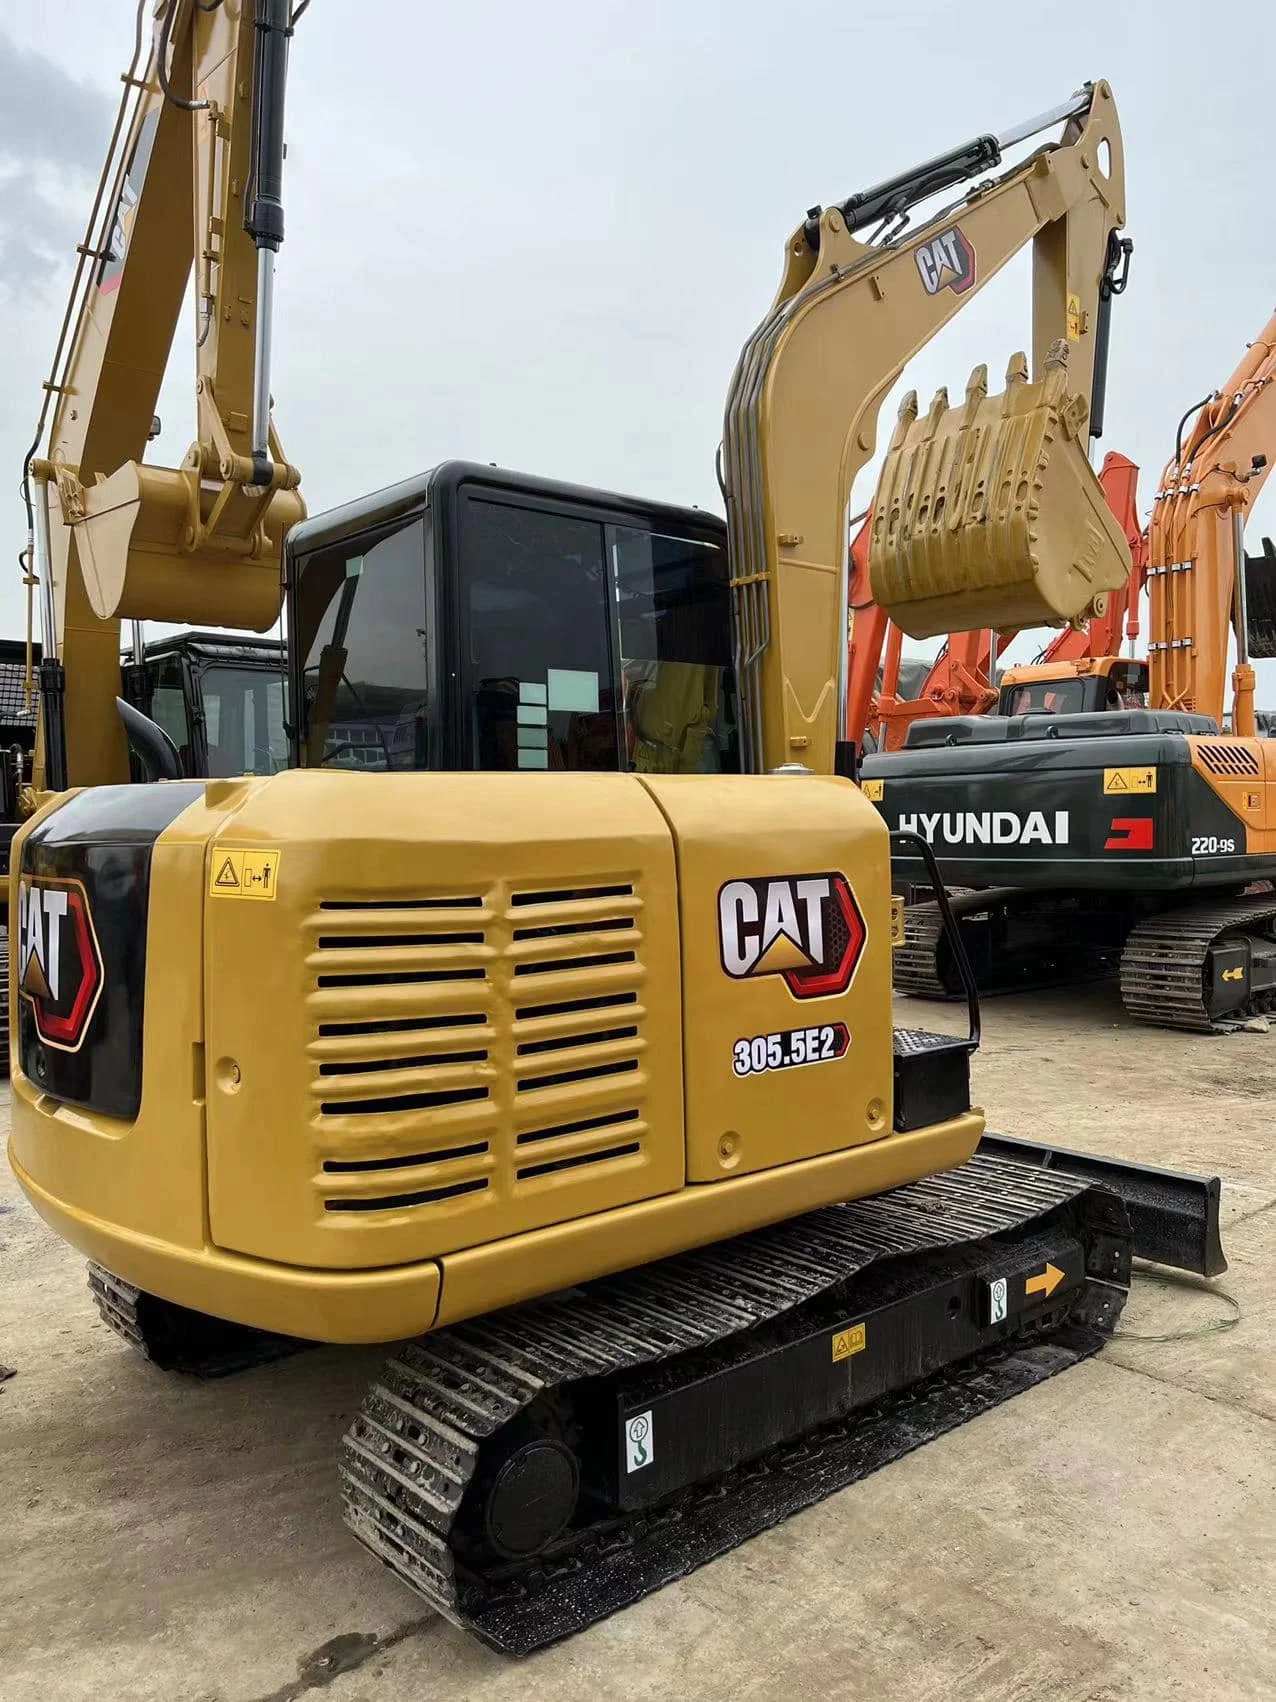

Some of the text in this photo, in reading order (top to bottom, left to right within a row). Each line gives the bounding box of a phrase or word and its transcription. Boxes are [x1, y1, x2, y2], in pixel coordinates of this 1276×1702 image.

[916, 230, 963, 293] CAT
[899, 811, 1069, 844] HYUNDAI
[1191, 836, 1235, 855] 220-9S
[18, 879, 68, 1001] CAT
[719, 878, 830, 976] CAT
[734, 1026, 835, 1074] 305.5E2
